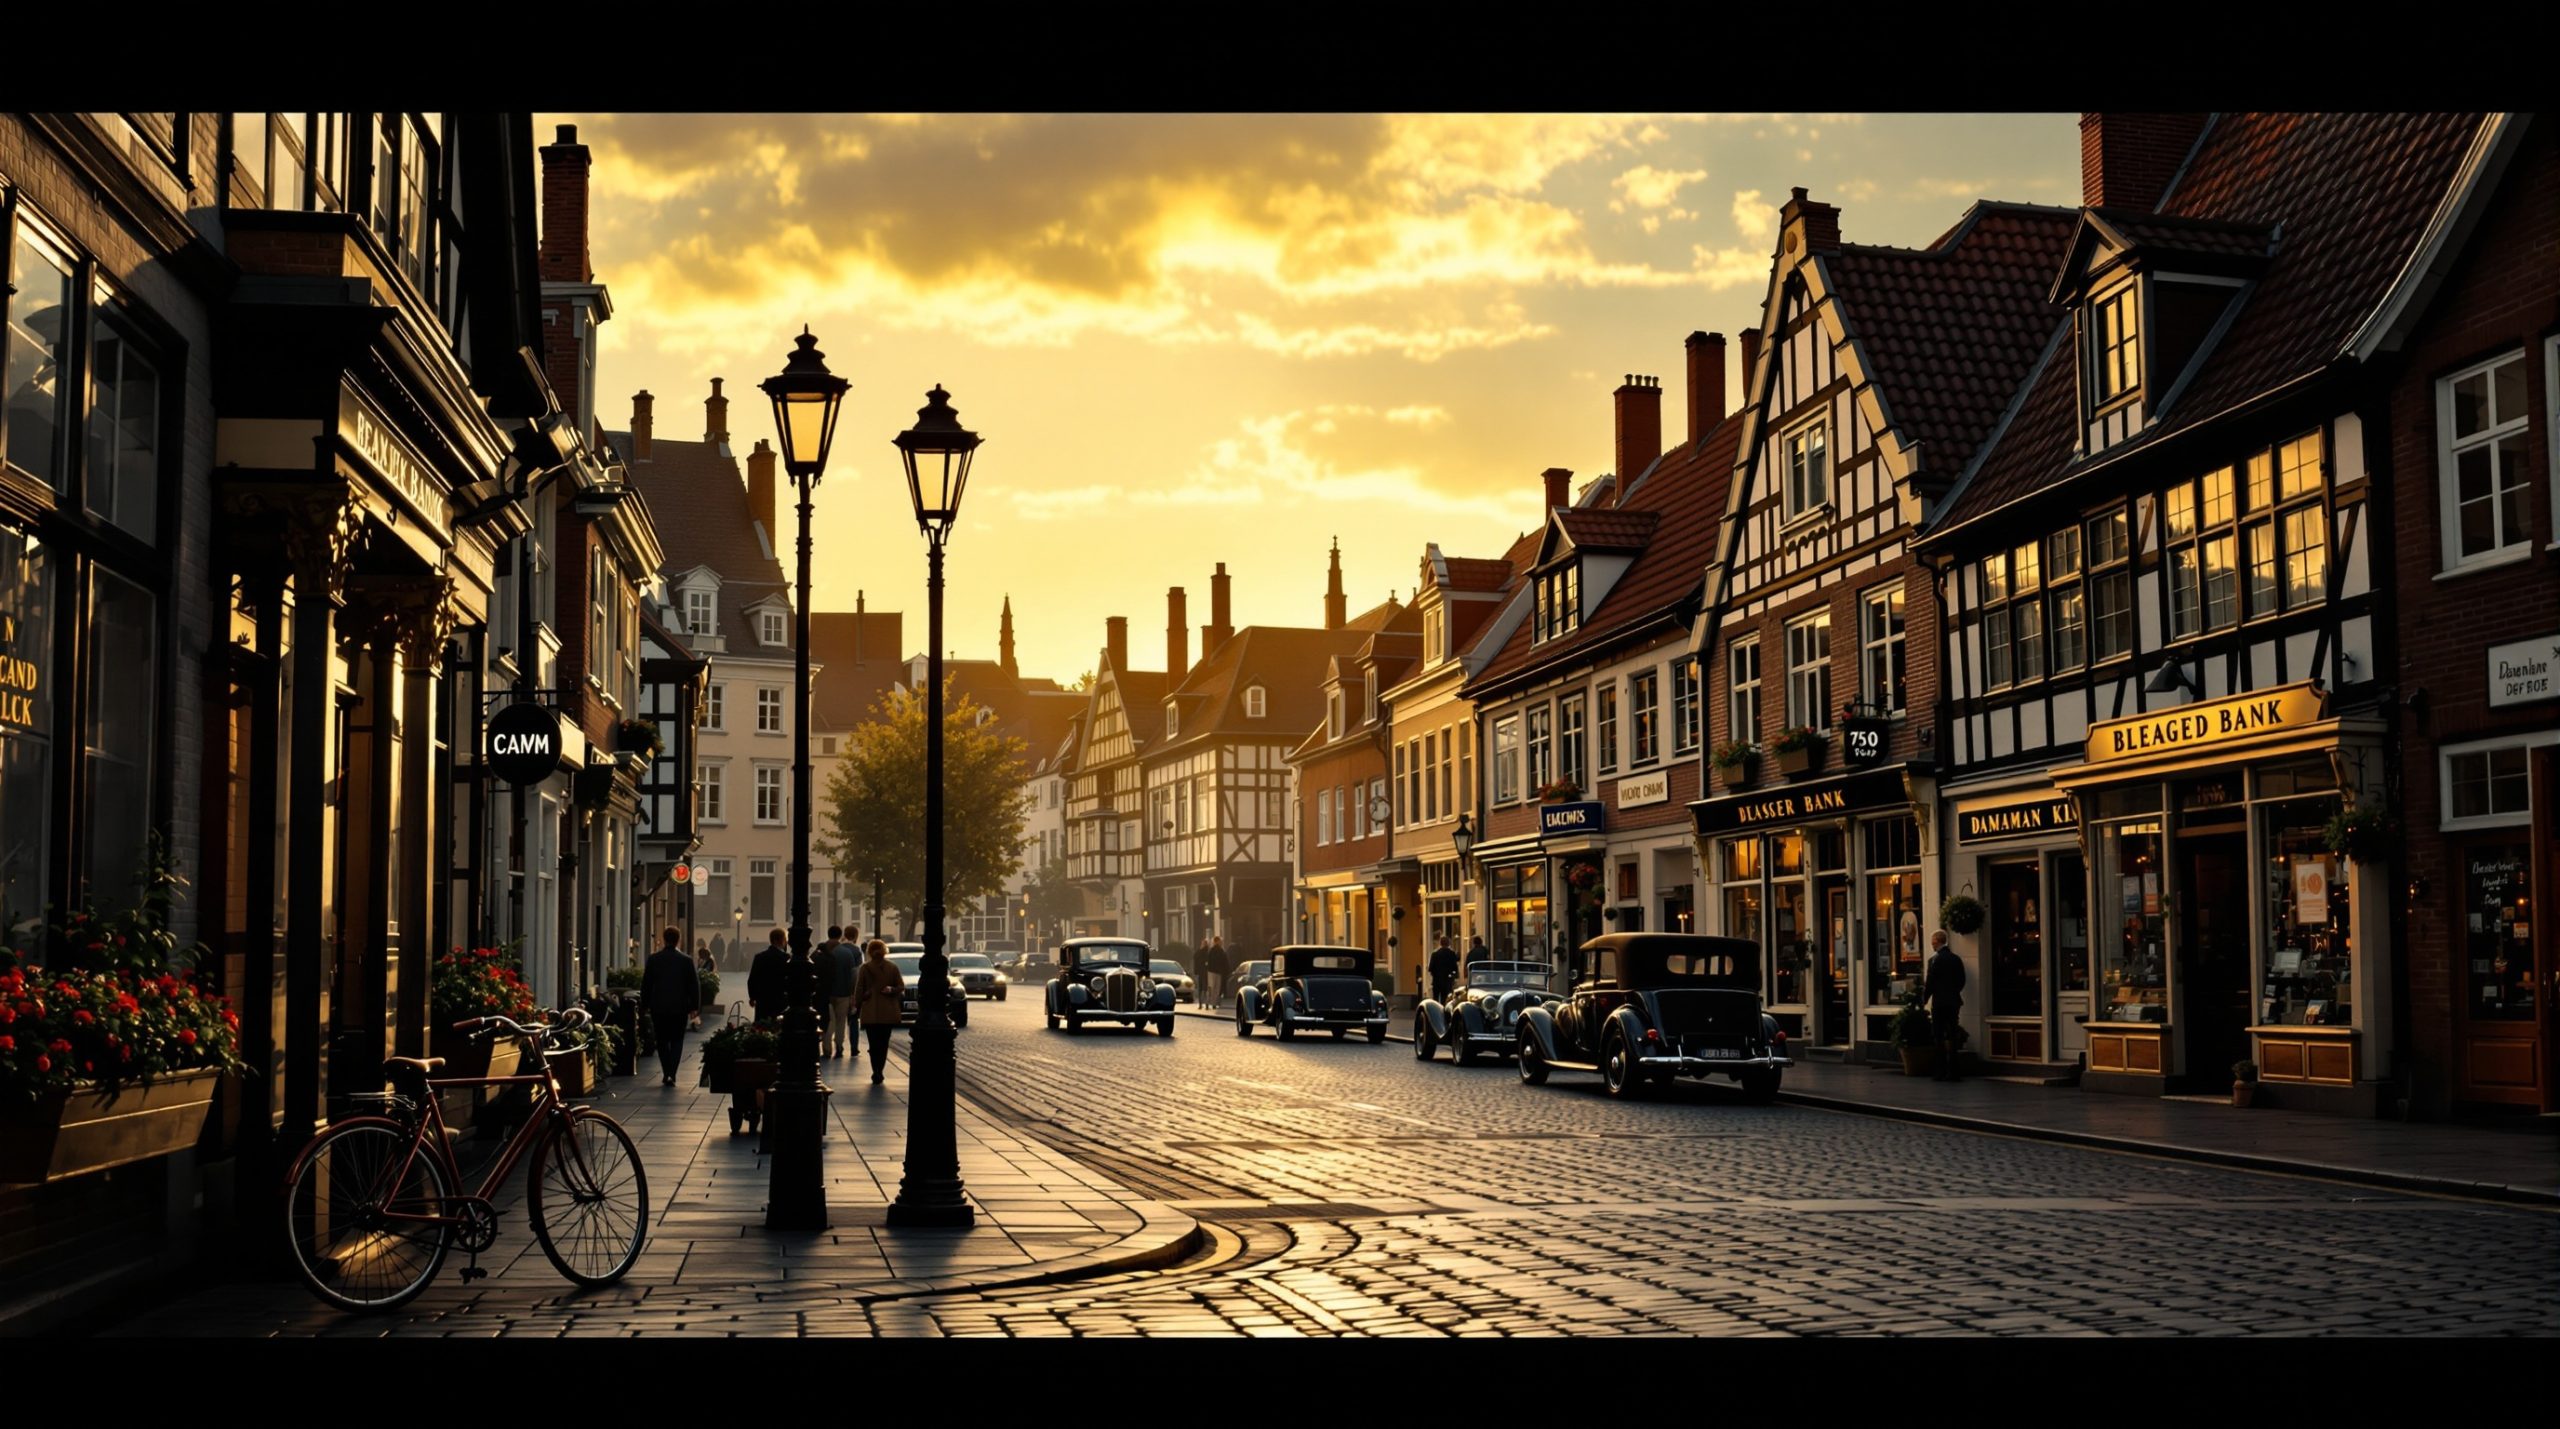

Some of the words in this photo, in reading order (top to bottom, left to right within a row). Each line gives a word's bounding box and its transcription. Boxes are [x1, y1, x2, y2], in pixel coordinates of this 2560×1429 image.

[2113, 714, 2208, 753] BLEAGED
[2219, 699, 2282, 733] BANK
[1850, 731, 1878, 747] 750
[1804, 789, 1845, 812] BANK
